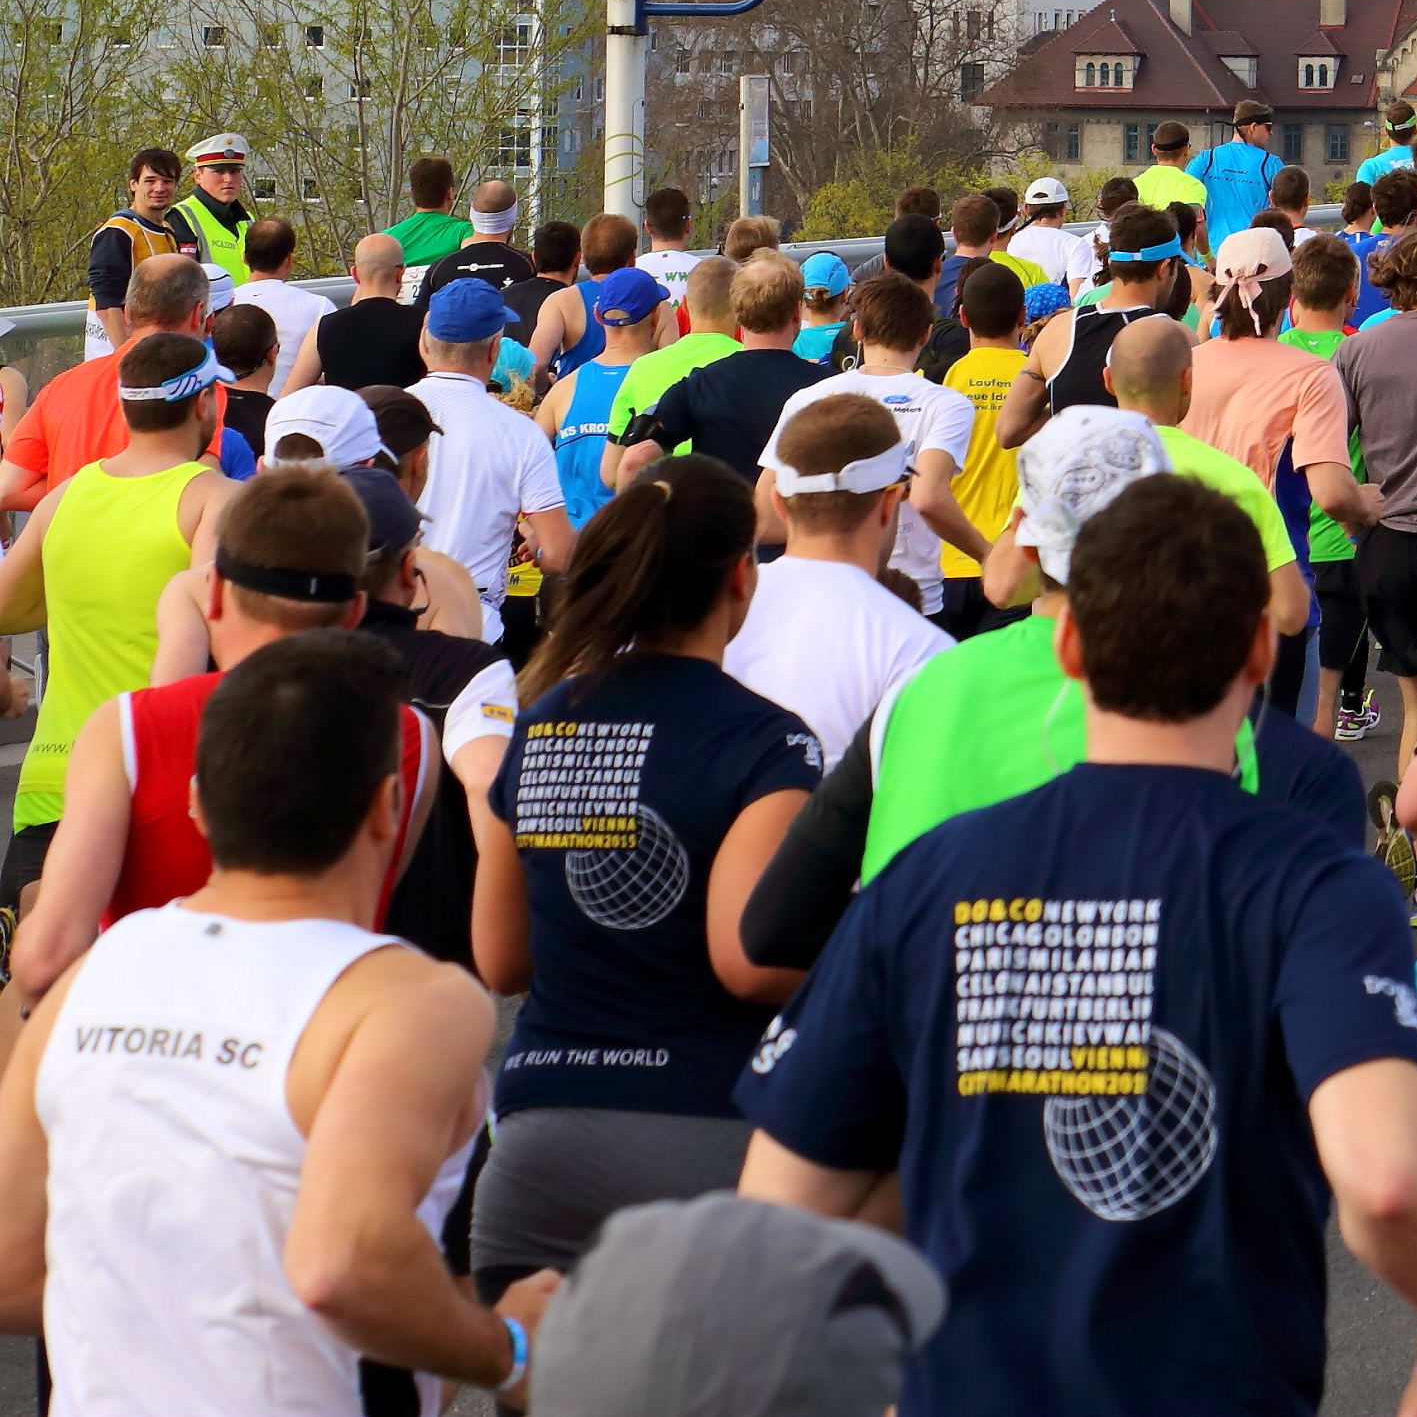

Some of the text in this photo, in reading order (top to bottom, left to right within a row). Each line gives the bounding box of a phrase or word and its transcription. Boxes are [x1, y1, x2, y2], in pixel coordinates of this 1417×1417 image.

[968, 377, 1012, 388] Laufen
[560, 425, 577, 440] KS
[76, 1026, 263, 1069] VITORIA SC
[523, 1048, 563, 1066] RUN
[565, 1047, 601, 1066] THE
[602, 1047, 671, 1067] WORLD
